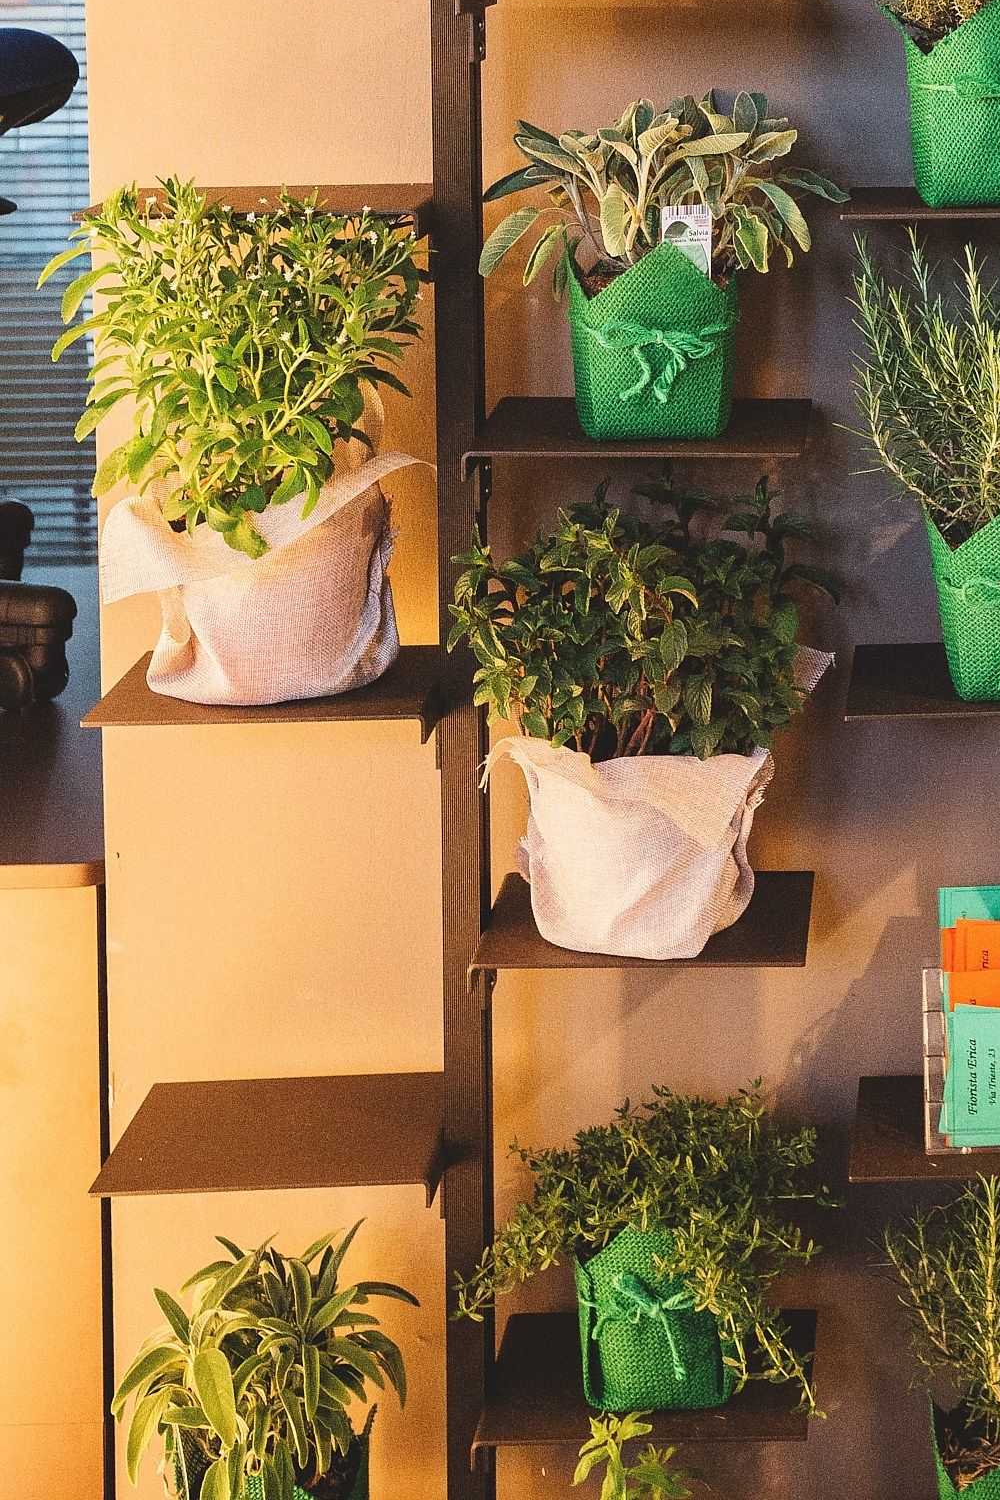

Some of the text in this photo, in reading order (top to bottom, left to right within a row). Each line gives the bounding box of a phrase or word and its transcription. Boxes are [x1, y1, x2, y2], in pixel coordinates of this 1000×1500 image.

[966, 1039, 978, 1115] Fiorista Erica
[988, 1048, 997, 1105] Via Trieste, 23
